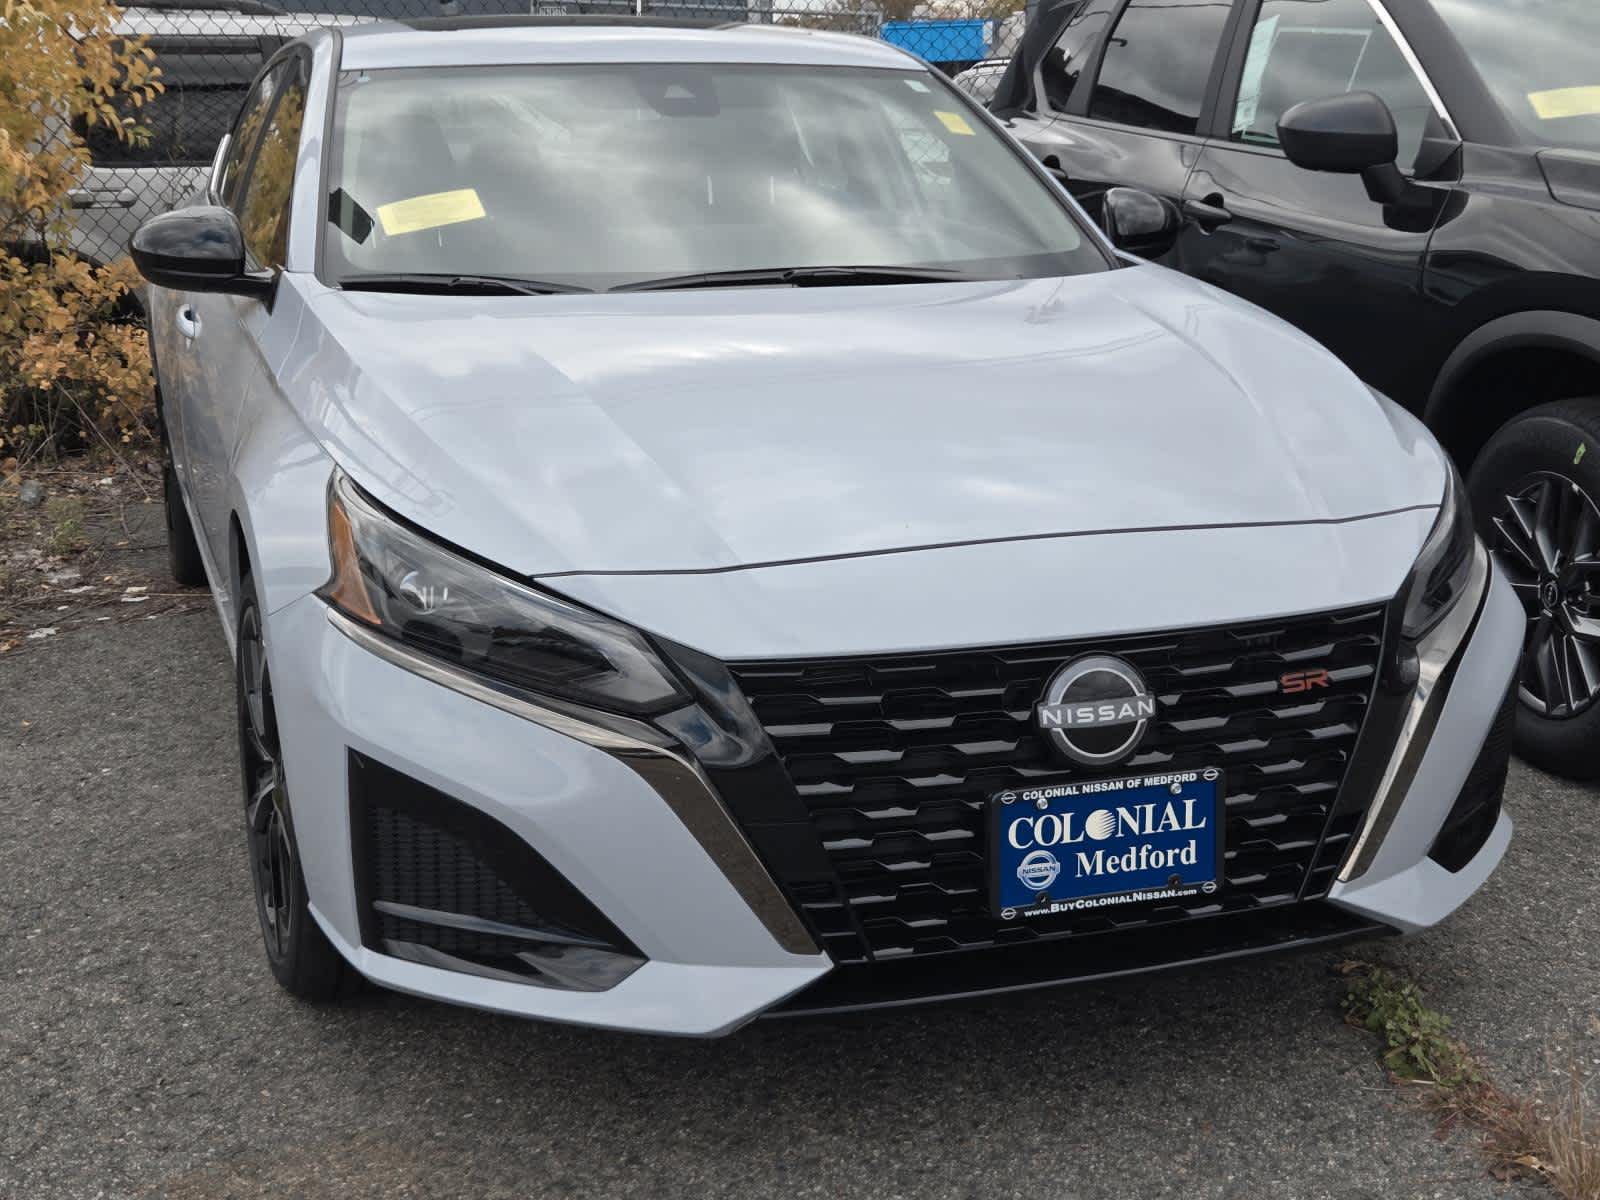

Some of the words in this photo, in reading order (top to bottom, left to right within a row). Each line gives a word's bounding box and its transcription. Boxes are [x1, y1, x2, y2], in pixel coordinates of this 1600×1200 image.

[1280, 669, 1329, 693] SR
[1042, 699, 1153, 725] NISSAN
[1023, 786, 1079, 800] COLONIAL
[1082, 780, 1123, 794] NISSAN
[1127, 779, 1142, 788] OF
[1144, 773, 1197, 787] MEDFORD
[1008, 799, 1206, 849] COLONIAL
[1022, 865, 1056, 875] NISSAN
[1075, 840, 1197, 878] Medford
